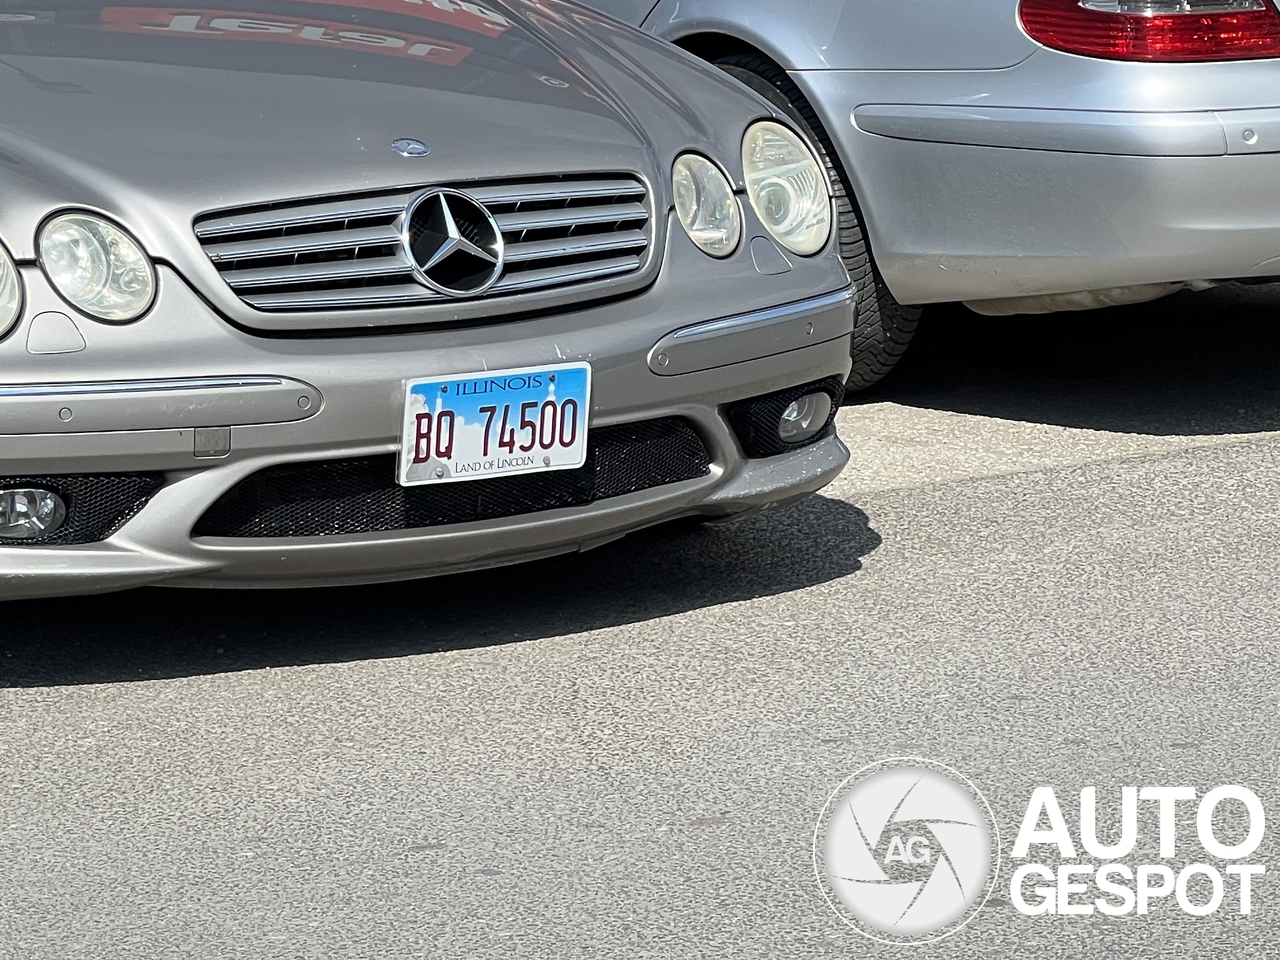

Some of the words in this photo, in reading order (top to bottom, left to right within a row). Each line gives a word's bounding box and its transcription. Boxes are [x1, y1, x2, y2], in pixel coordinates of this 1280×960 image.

[455, 374, 543, 396] ILLINOIS
[412, 410, 455, 464] BQ
[479, 398, 578, 457] 74500
